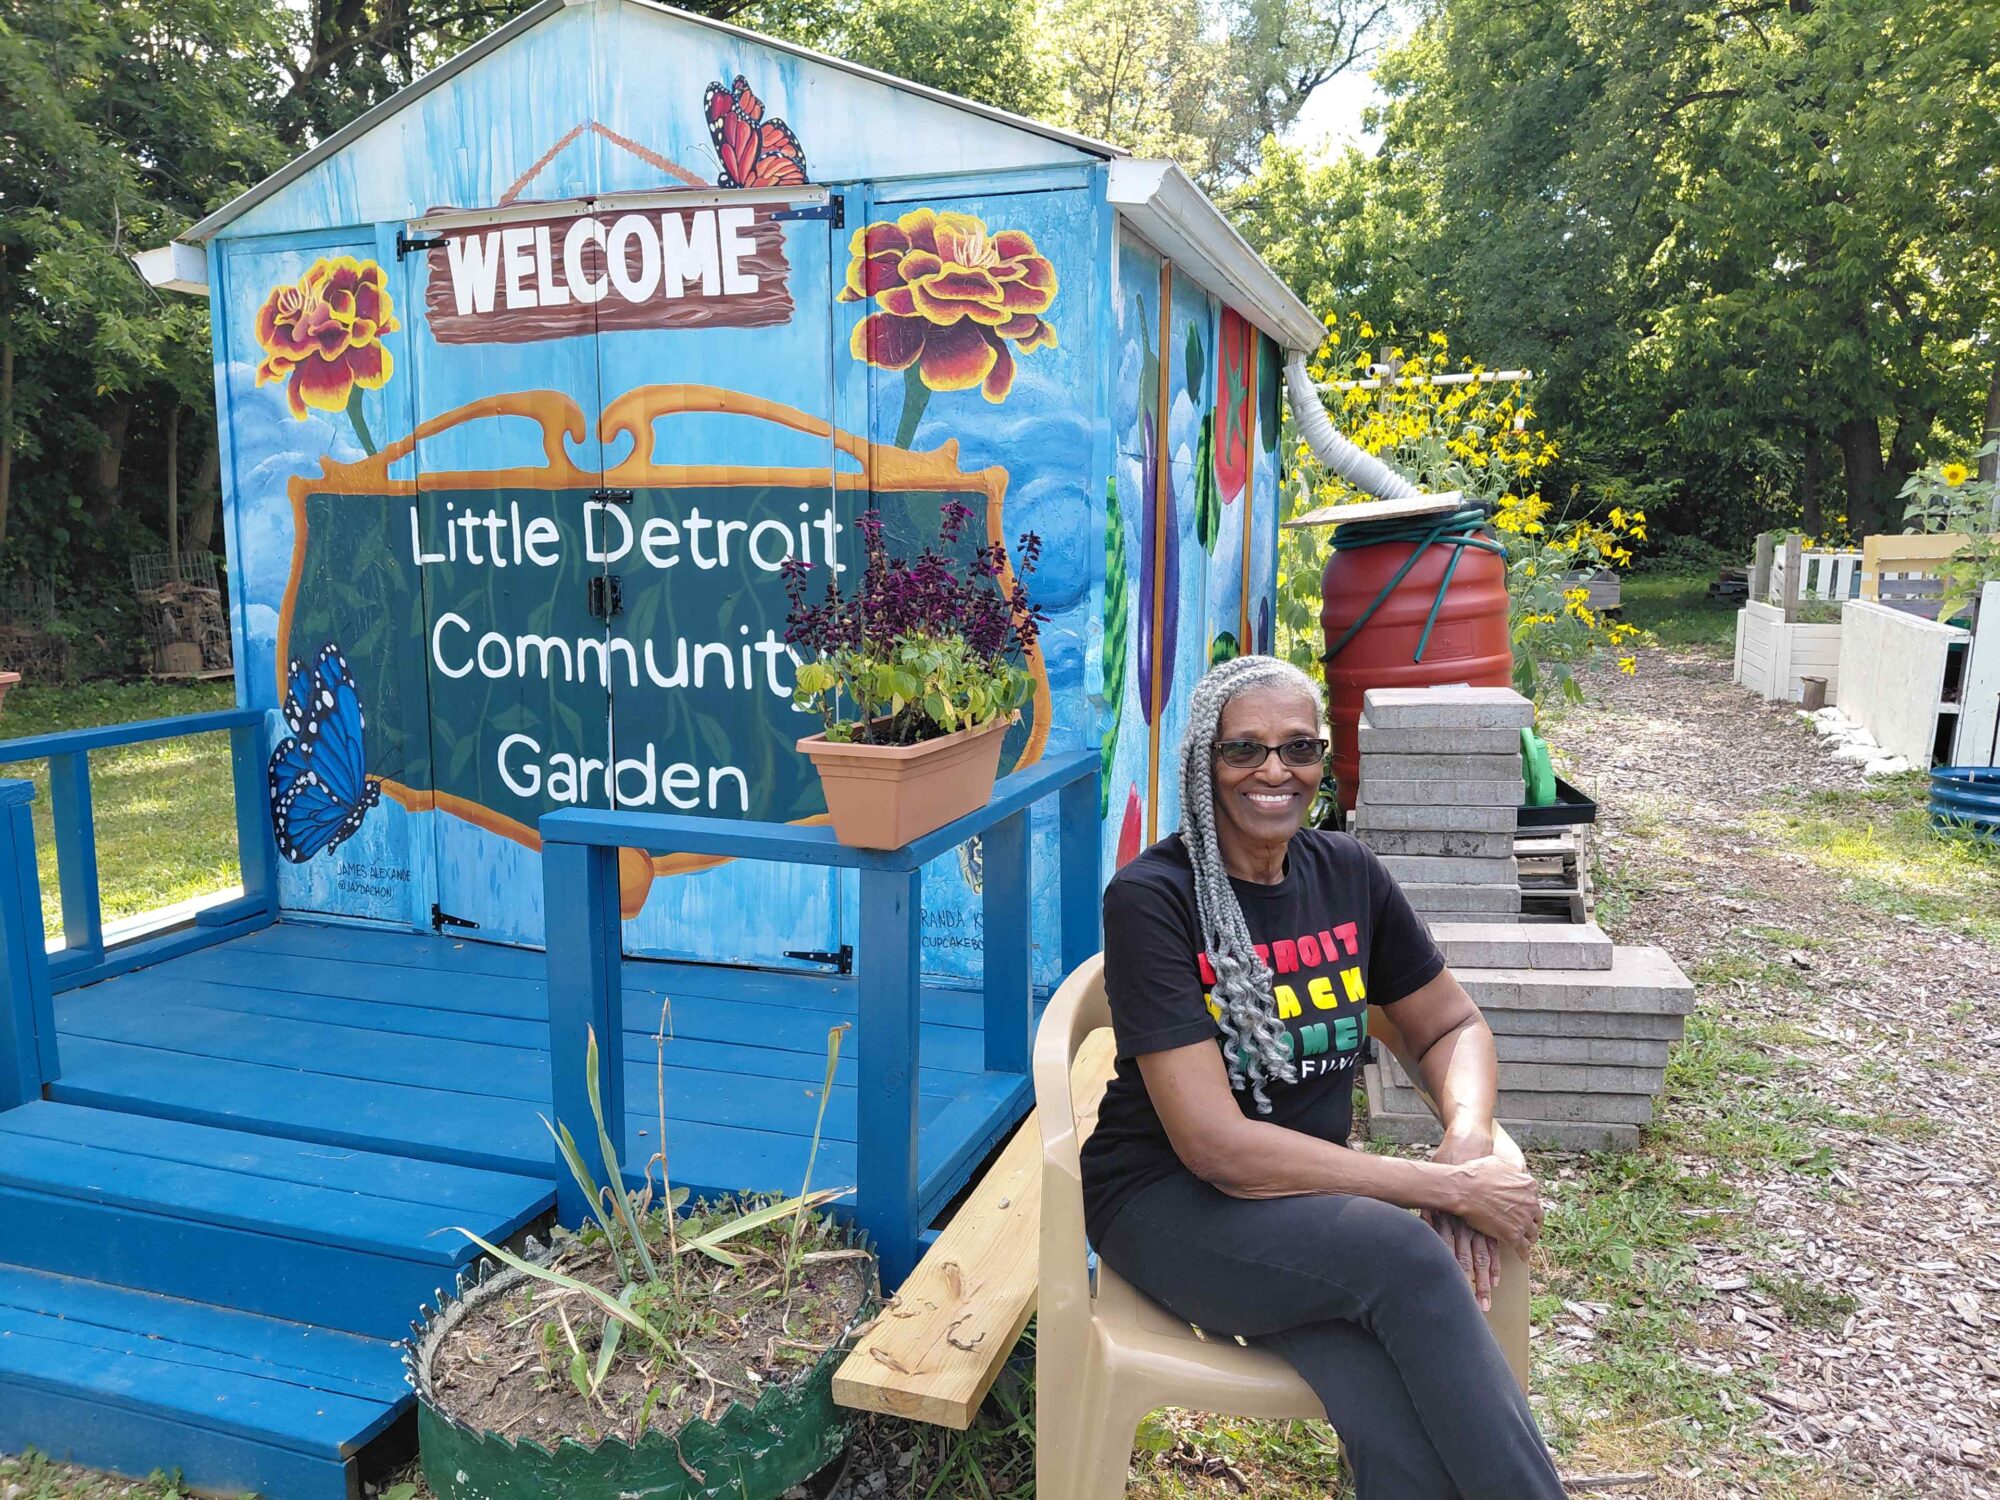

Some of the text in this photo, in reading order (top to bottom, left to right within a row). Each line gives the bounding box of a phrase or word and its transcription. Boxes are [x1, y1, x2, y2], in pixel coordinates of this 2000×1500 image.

[447, 207, 759, 316] WELCOME
[410, 501, 846, 572] Little Detroit
[432, 612, 827, 712] Community
[497, 733, 749, 812] Garden
[337, 861, 368, 879] JAMES
[973, 912, 983, 930] K
[1197, 921, 1359, 985] TROIT
[1203, 966, 1367, 1023] ACK
